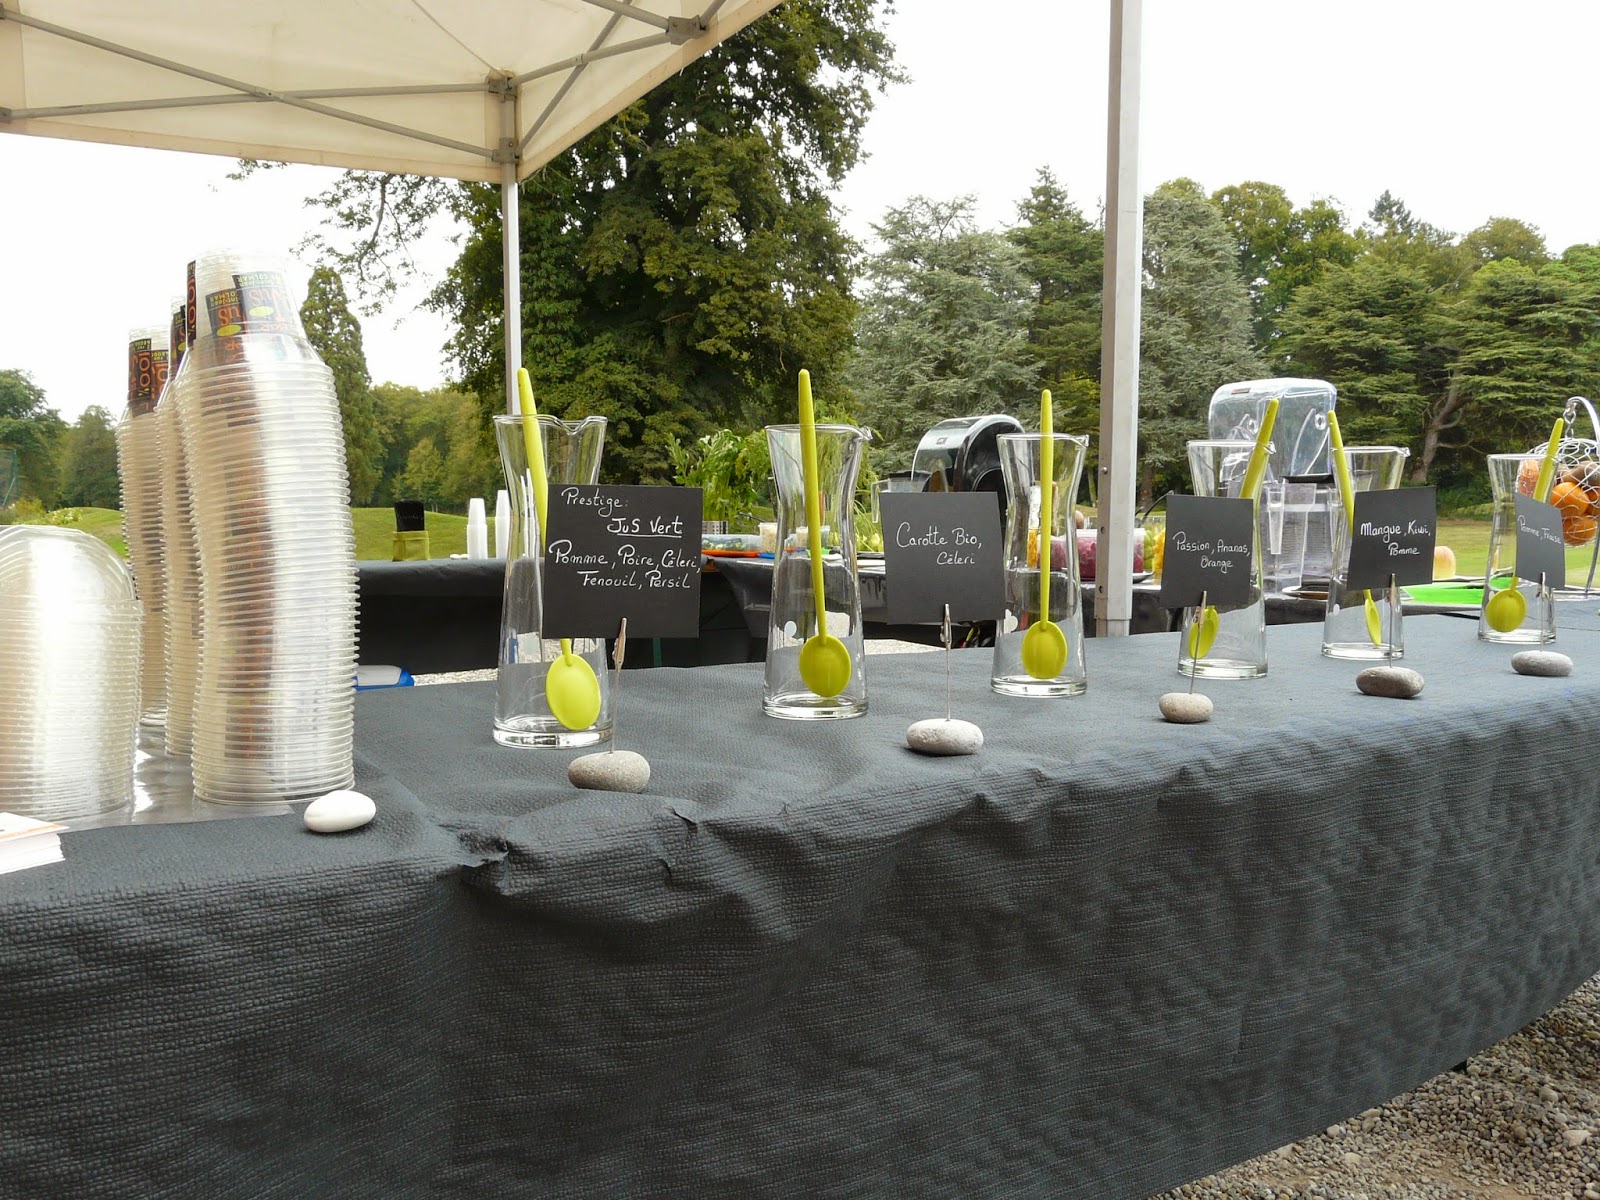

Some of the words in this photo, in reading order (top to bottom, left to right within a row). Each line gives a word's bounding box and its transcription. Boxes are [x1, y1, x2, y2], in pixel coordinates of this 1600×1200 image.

[561, 486, 628, 518] Prestige:
[649, 515, 683, 535] Vert
[896, 521, 948, 548] Carotte
[951, 527, 982, 549] Bio,
[1407, 519, 1431, 537] Kiwi,
[548, 539, 616, 569] Pomme,
[617, 544, 659, 571] Poire,
[1217, 538, 1251, 557] Ananas,
[1387, 542, 1421, 556] Pomme
[1200, 554, 1234, 574] Orange
[576, 570, 643, 590] Fenouil,
[645, 570, 691, 589] Persil
